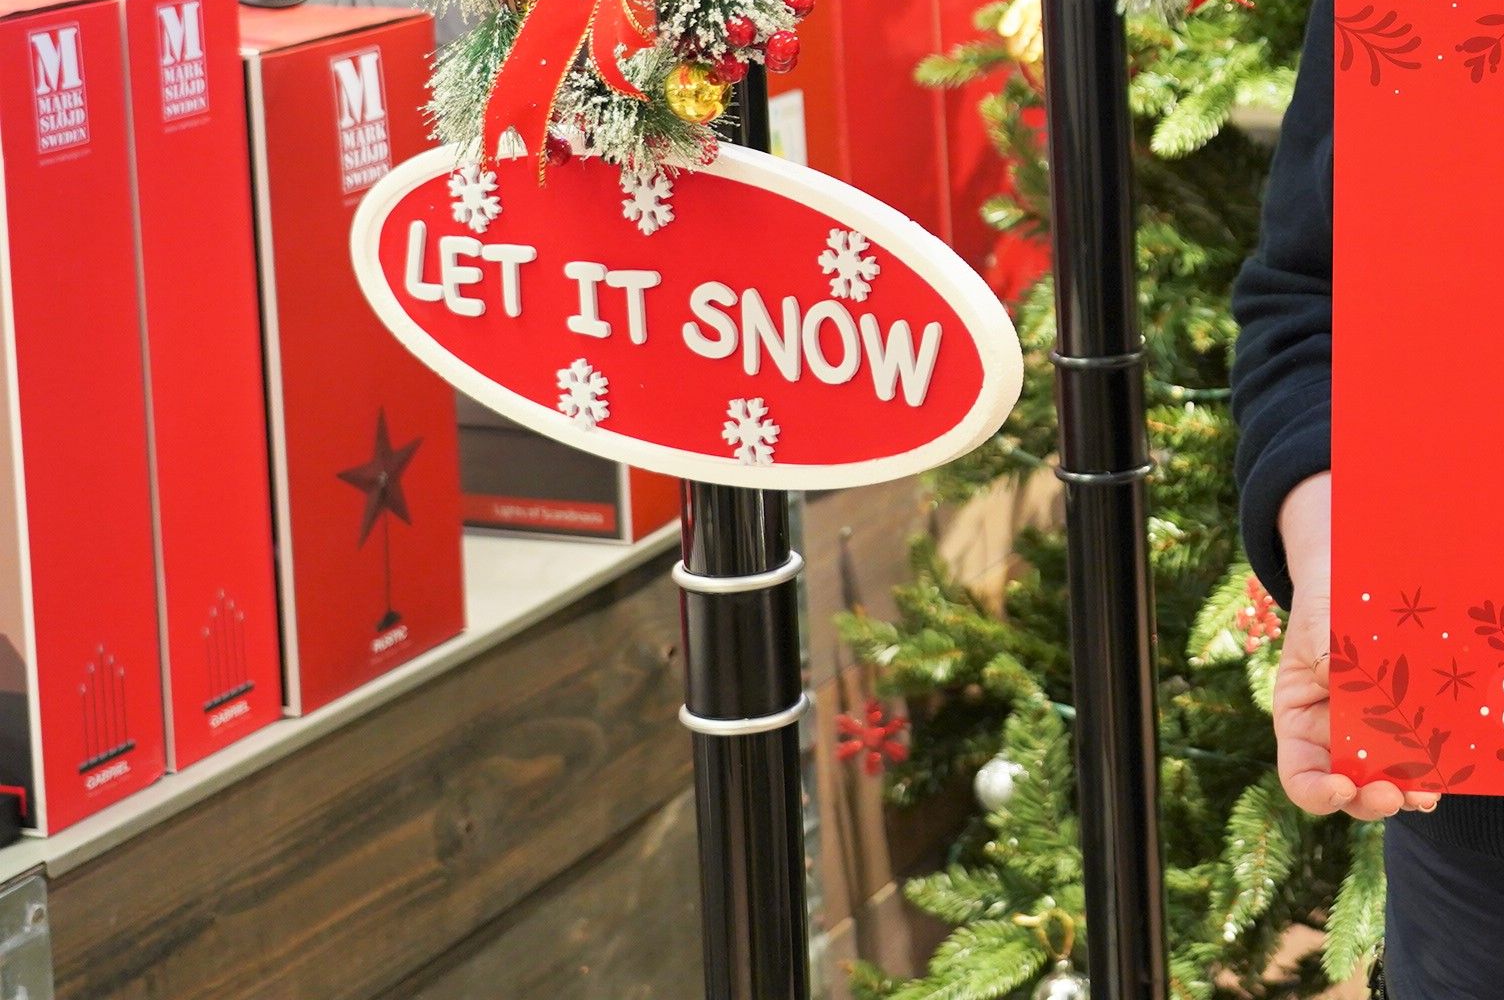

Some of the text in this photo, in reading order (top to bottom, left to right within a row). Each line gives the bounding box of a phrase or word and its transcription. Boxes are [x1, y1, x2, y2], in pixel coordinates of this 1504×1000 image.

[31, 27, 83, 95] M
[159, 1, 203, 67] M
[38, 91, 84, 115] MARK
[334, 52, 385, 129] M
[404, 219, 942, 407] LET IT SNOW
